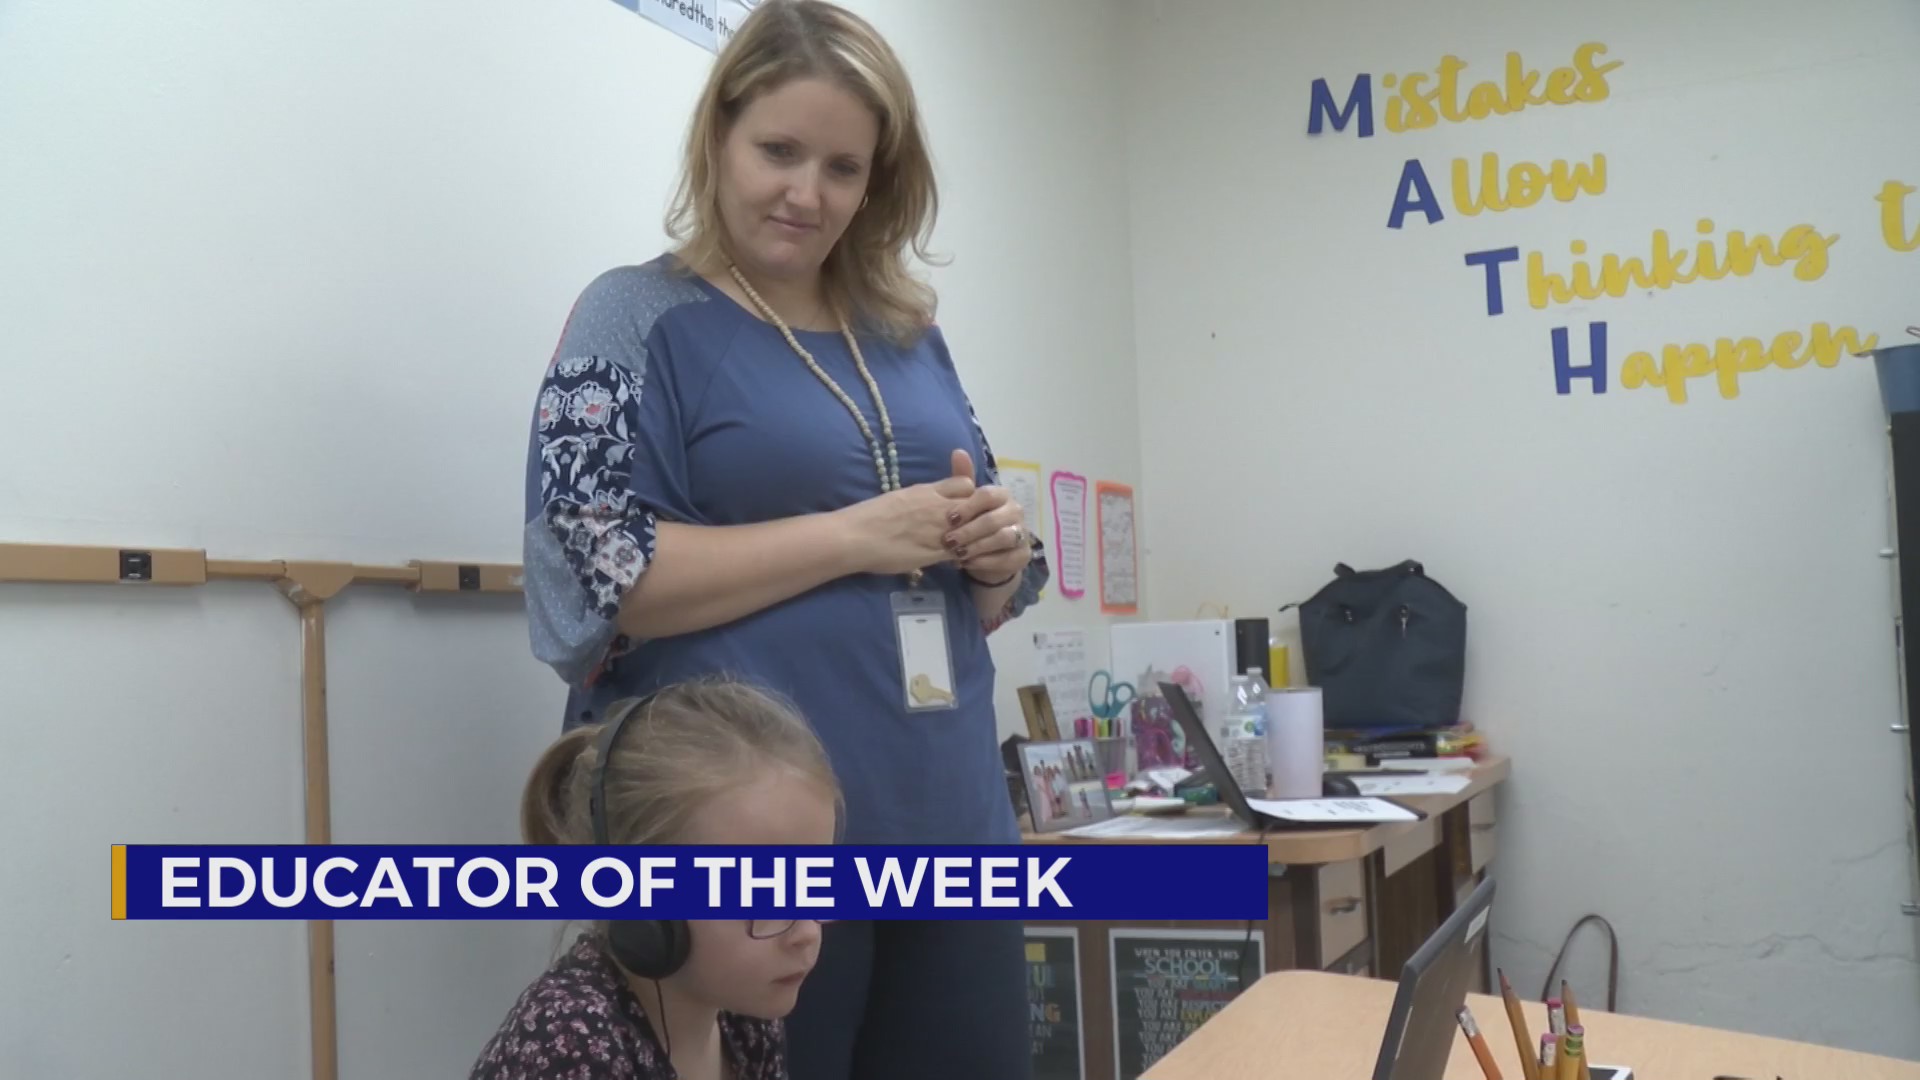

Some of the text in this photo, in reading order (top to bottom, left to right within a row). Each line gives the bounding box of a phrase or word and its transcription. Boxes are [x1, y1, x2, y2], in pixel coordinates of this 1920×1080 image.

[1307, 42, 1624, 138] Mistakes
[1387, 153, 1607, 229] Allow
[1464, 180, 1920, 316] Thinking t
[1551, 321, 1879, 404] Happen
[1144, 958, 1224, 976] SCHOOL
